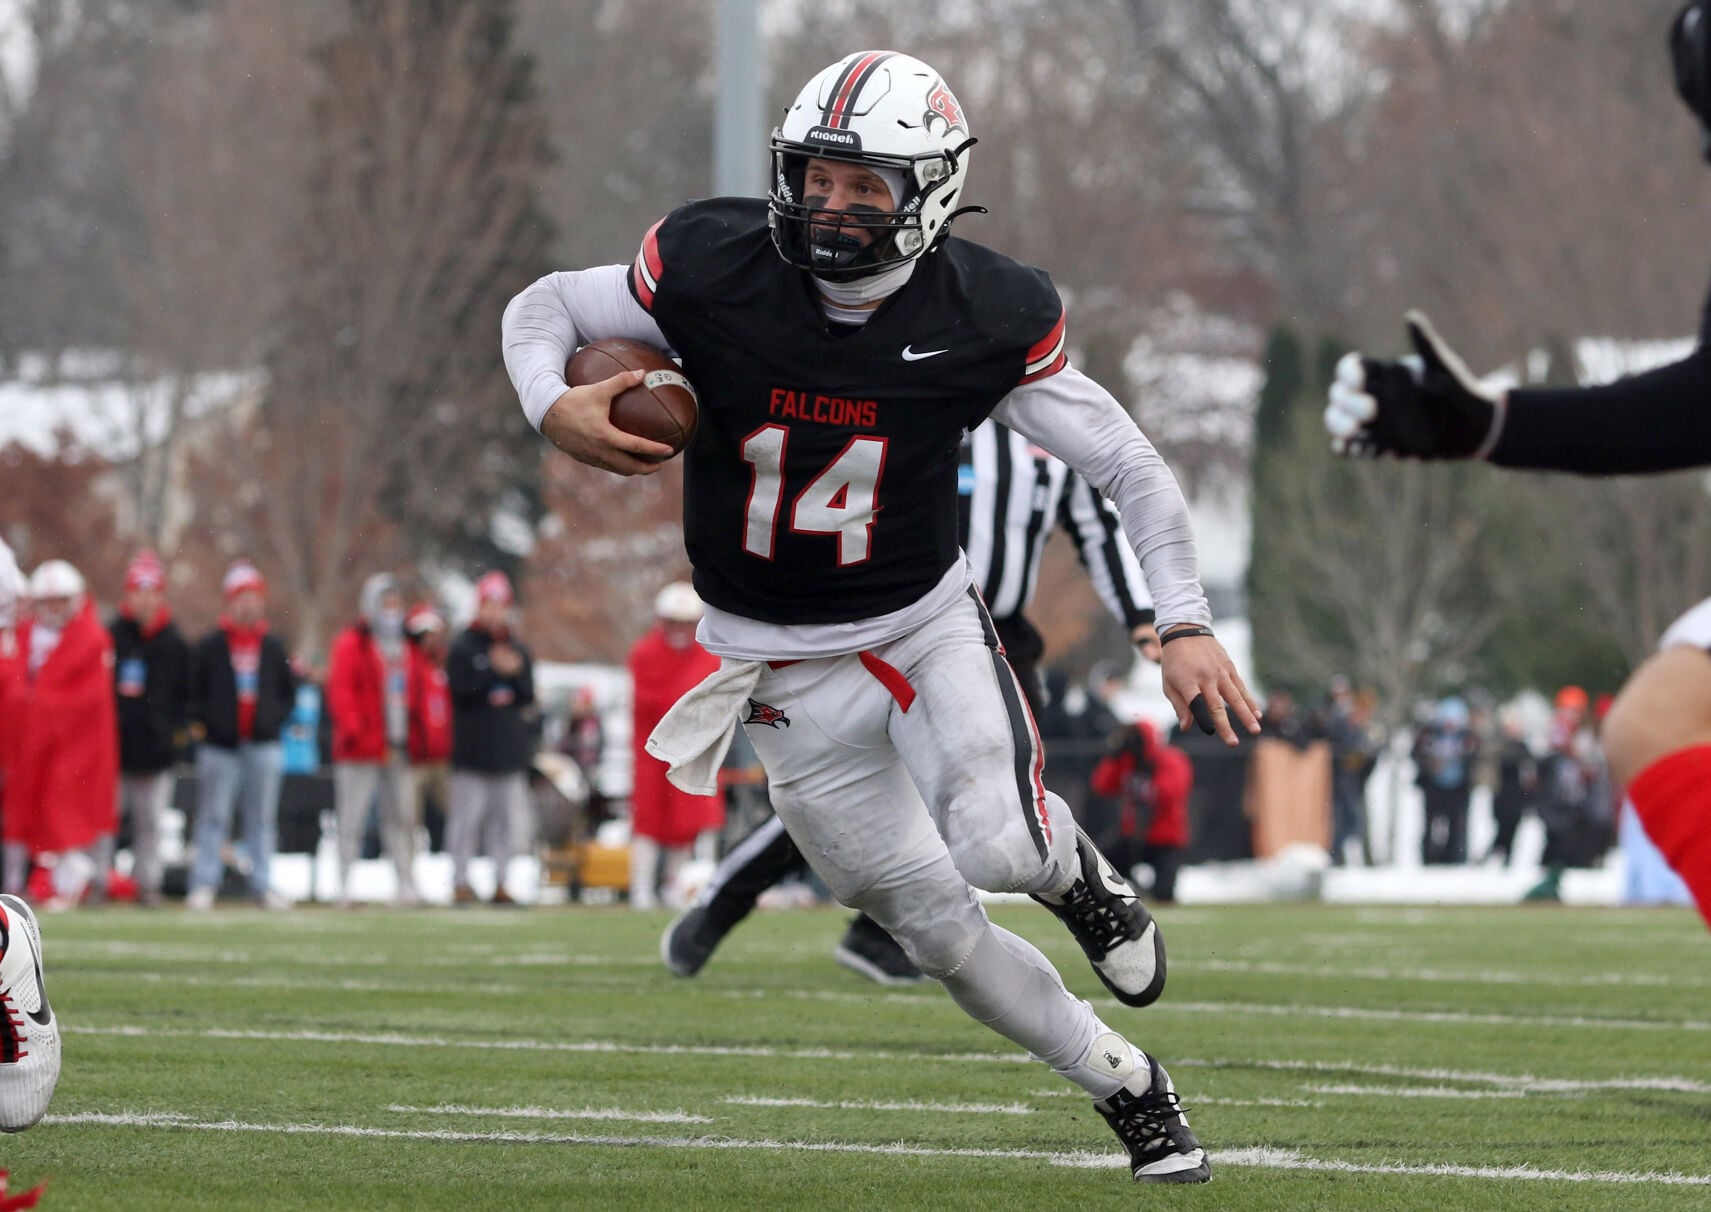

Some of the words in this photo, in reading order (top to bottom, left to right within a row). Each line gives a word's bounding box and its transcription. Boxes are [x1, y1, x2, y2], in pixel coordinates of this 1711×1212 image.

[779, 173, 793, 203] Ridde
[769, 388, 878, 427] FALCONS
[740, 422, 889, 568] 14
